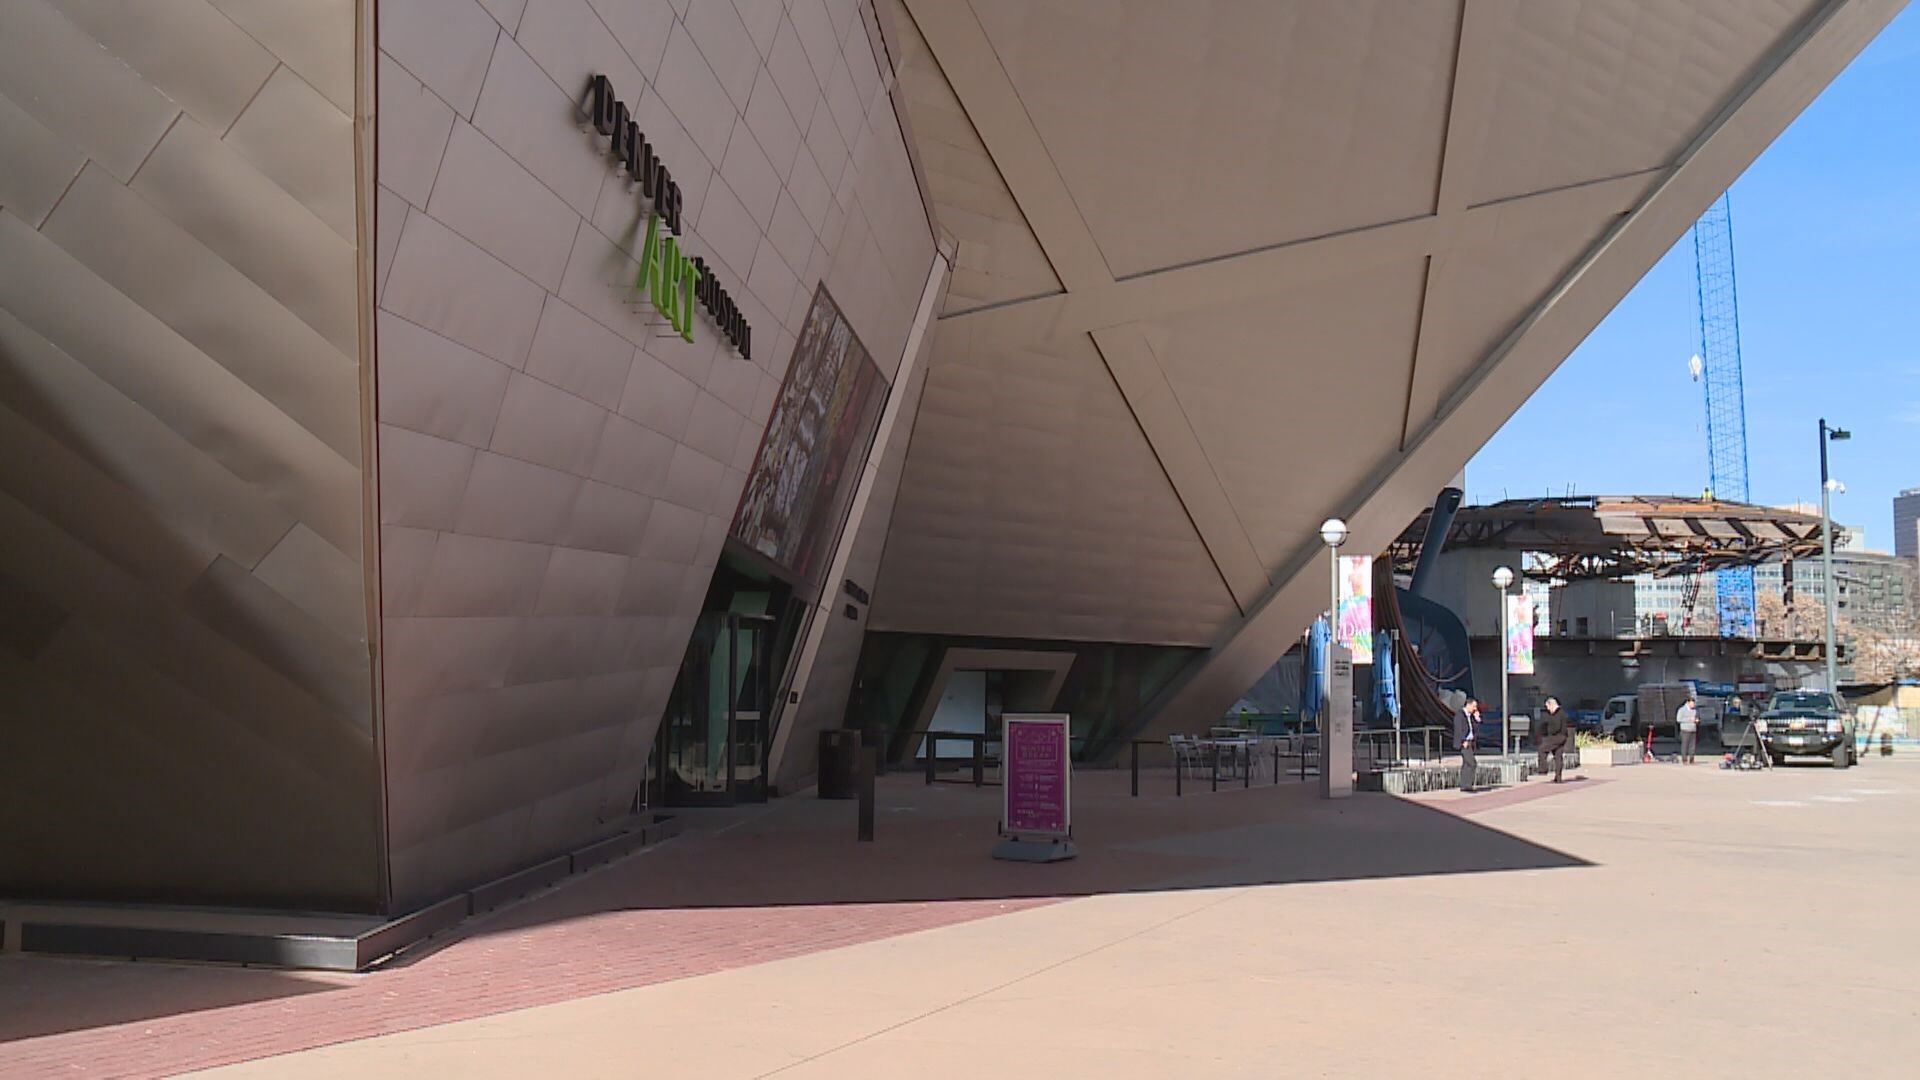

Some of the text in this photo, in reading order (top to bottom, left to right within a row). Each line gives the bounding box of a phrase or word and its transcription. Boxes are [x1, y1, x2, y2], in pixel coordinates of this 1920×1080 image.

[593, 75, 683, 236] DENVER
[636, 214, 702, 343] ART
[690, 256, 752, 360] MUSEUM
